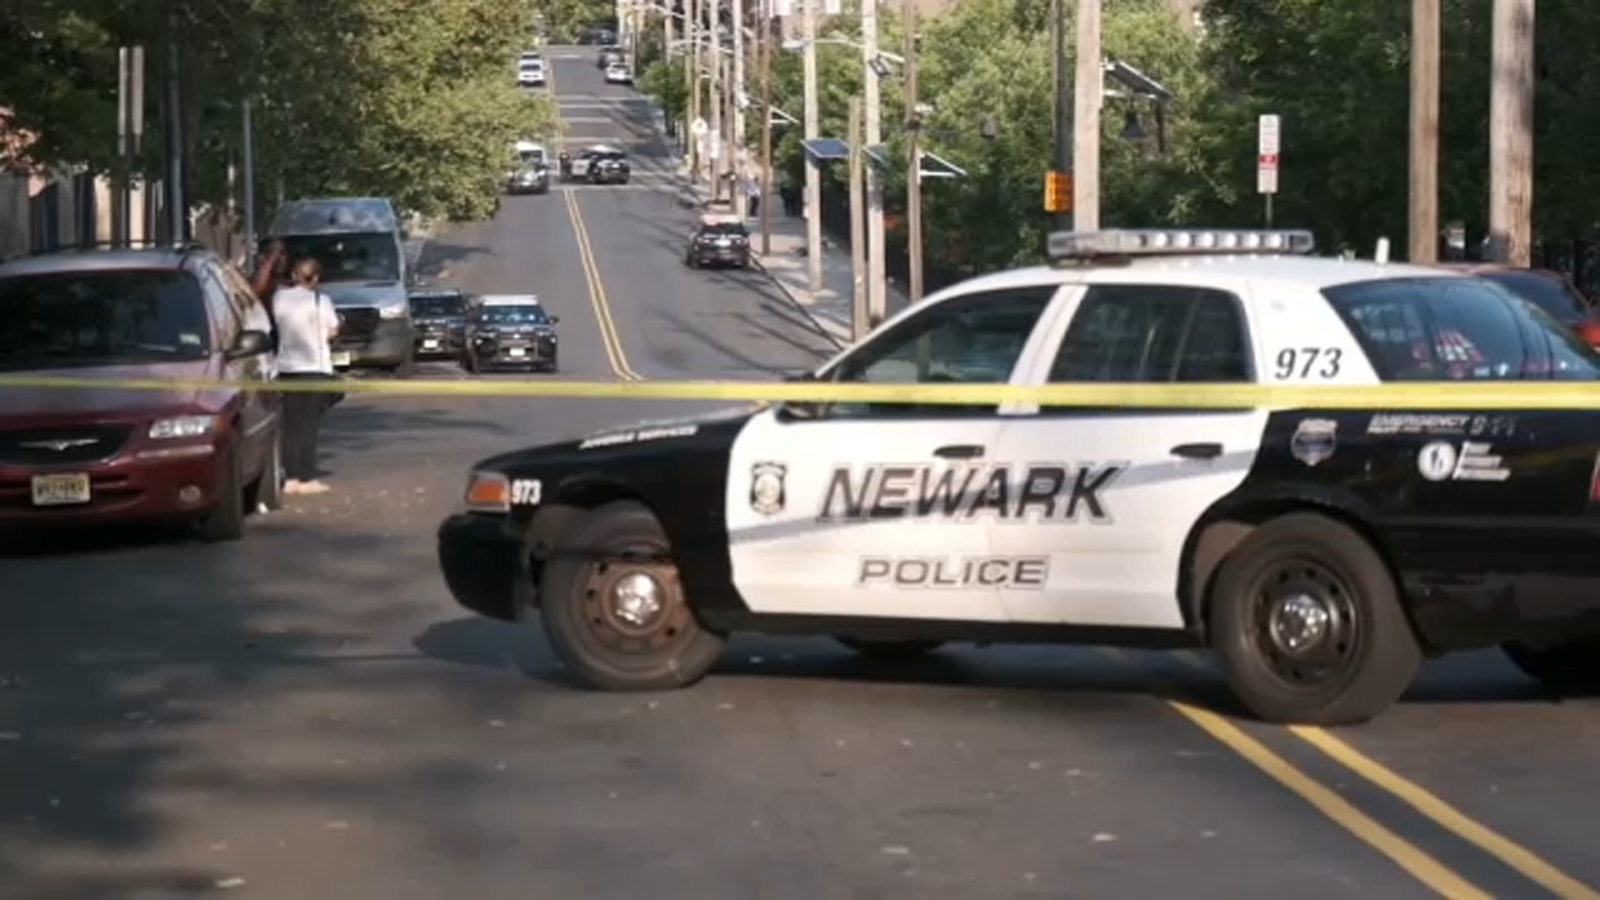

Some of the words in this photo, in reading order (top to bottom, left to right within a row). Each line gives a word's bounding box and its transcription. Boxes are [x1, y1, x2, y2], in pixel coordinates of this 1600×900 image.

[1275, 347, 1343, 380] 973
[512, 479, 542, 504] 973
[817, 463, 1126, 521] NEWARK
[858, 556, 1047, 586] POLICE
